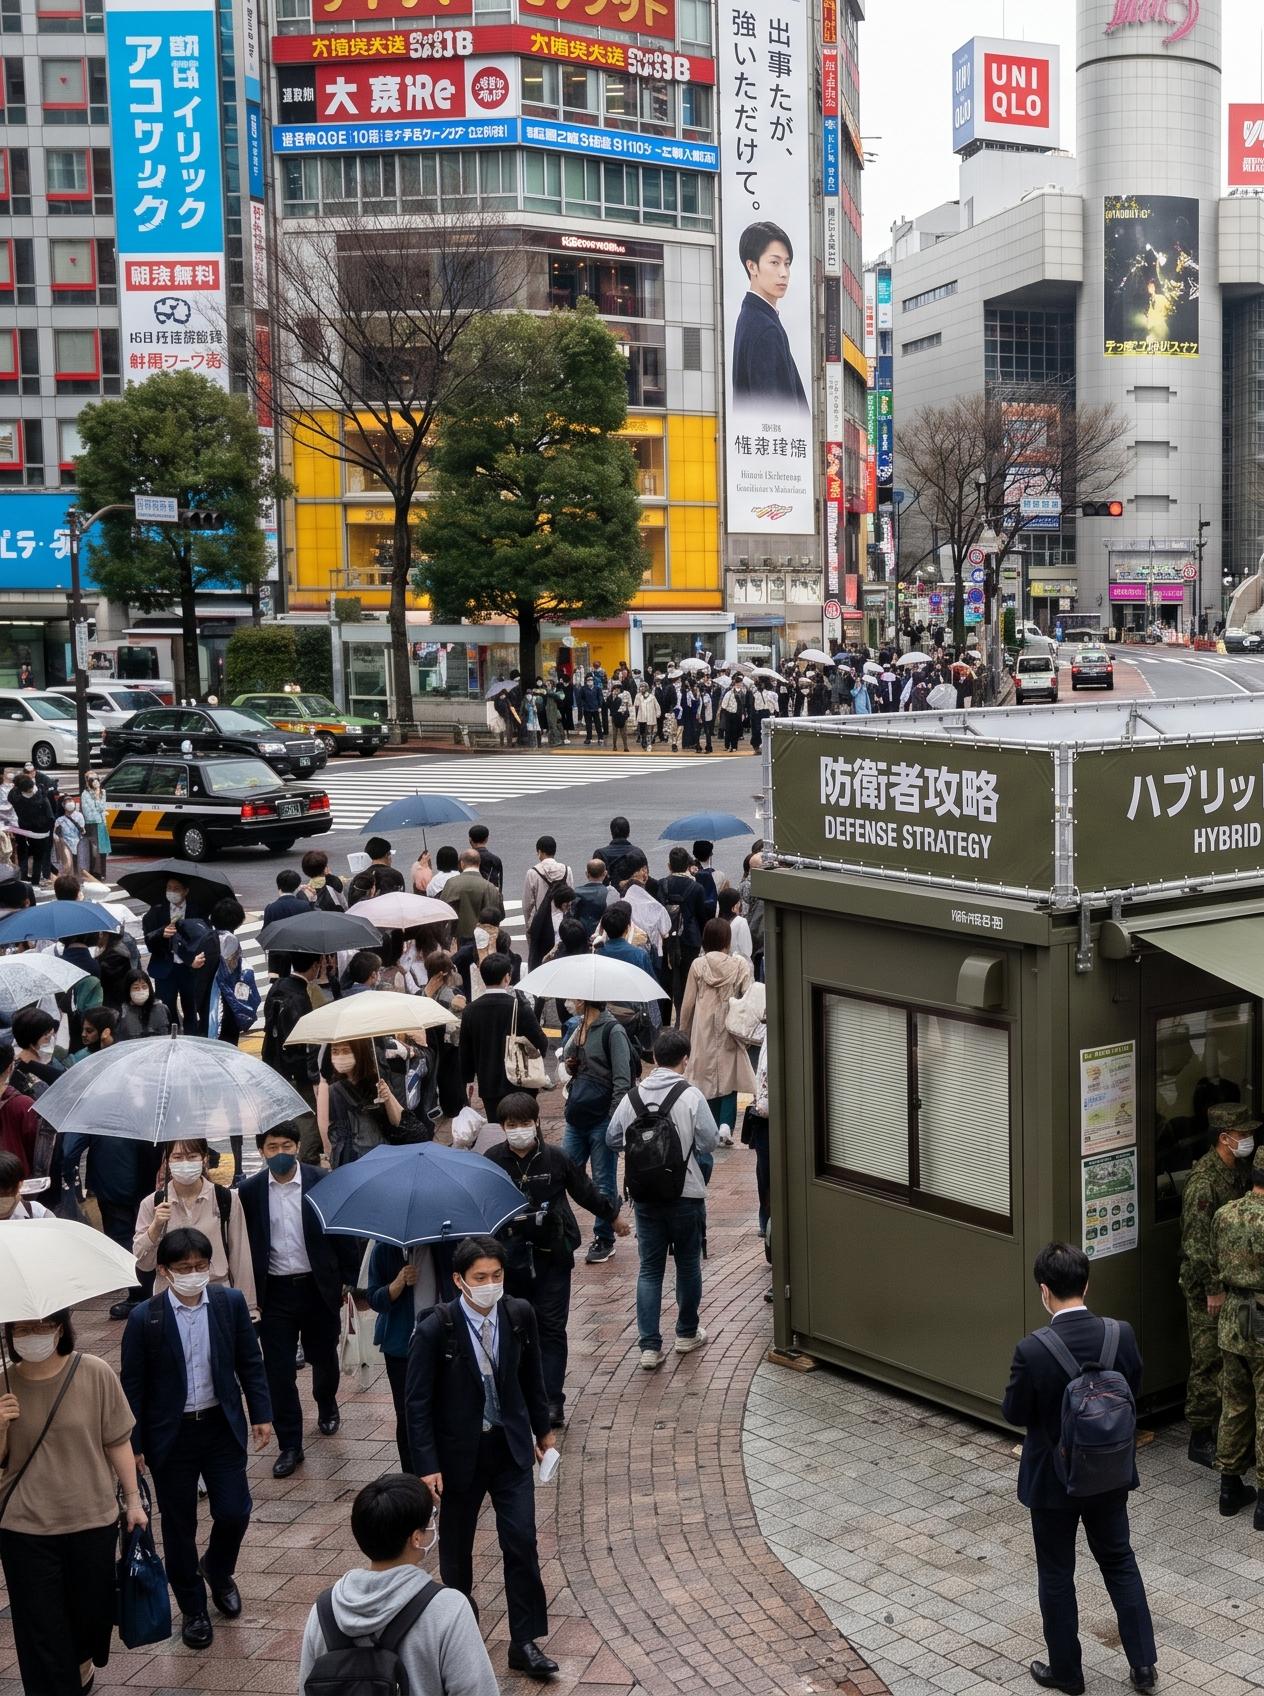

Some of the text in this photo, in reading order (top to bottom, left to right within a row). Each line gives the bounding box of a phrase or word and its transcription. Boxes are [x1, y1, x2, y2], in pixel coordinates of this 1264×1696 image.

[991, 62, 1038, 90] UNI
[991, 91, 1042, 118] QLO
[819, 756, 1000, 823] 防衛者攻略
[824, 815, 993, 860] DEFENSE STRATEGY
[1194, 822, 1261, 854] HYBRID
